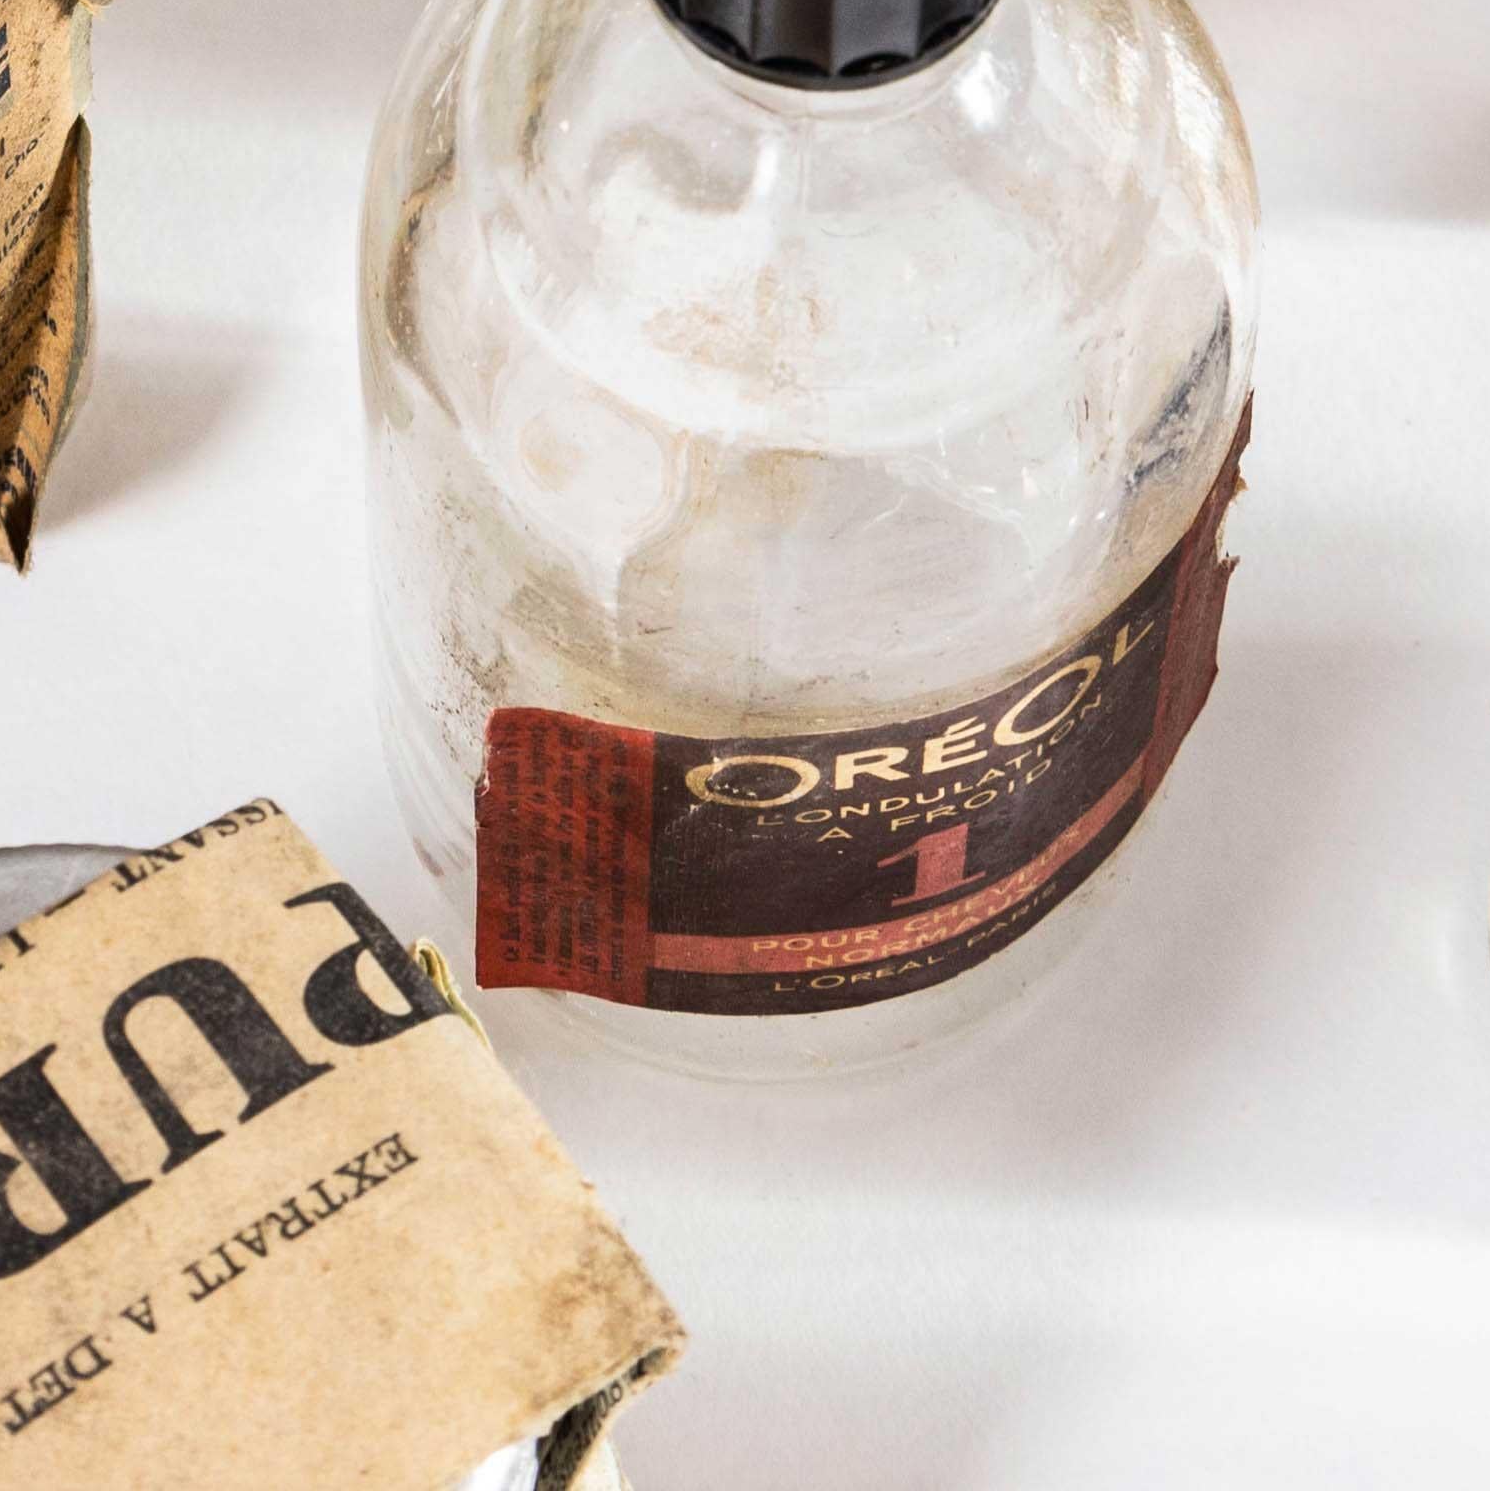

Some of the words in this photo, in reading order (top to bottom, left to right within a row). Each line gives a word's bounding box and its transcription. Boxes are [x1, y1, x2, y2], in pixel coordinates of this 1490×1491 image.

[4, 181, 44, 235] jeun
[684, 619, 1155, 809] ORÉOL
[756, 692, 1104, 827] L'ONDULATION
[816, 826, 853, 843] A
[890, 758, 1053, 834] FROID
[876, 821, 987, 909] 1
[752, 928, 881, 954] POUR
[805, 871, 1045, 969] NORMAUX
[182, 1131, 419, 1305] EXTRAIT
[119, 1295, 161, 1335] A
